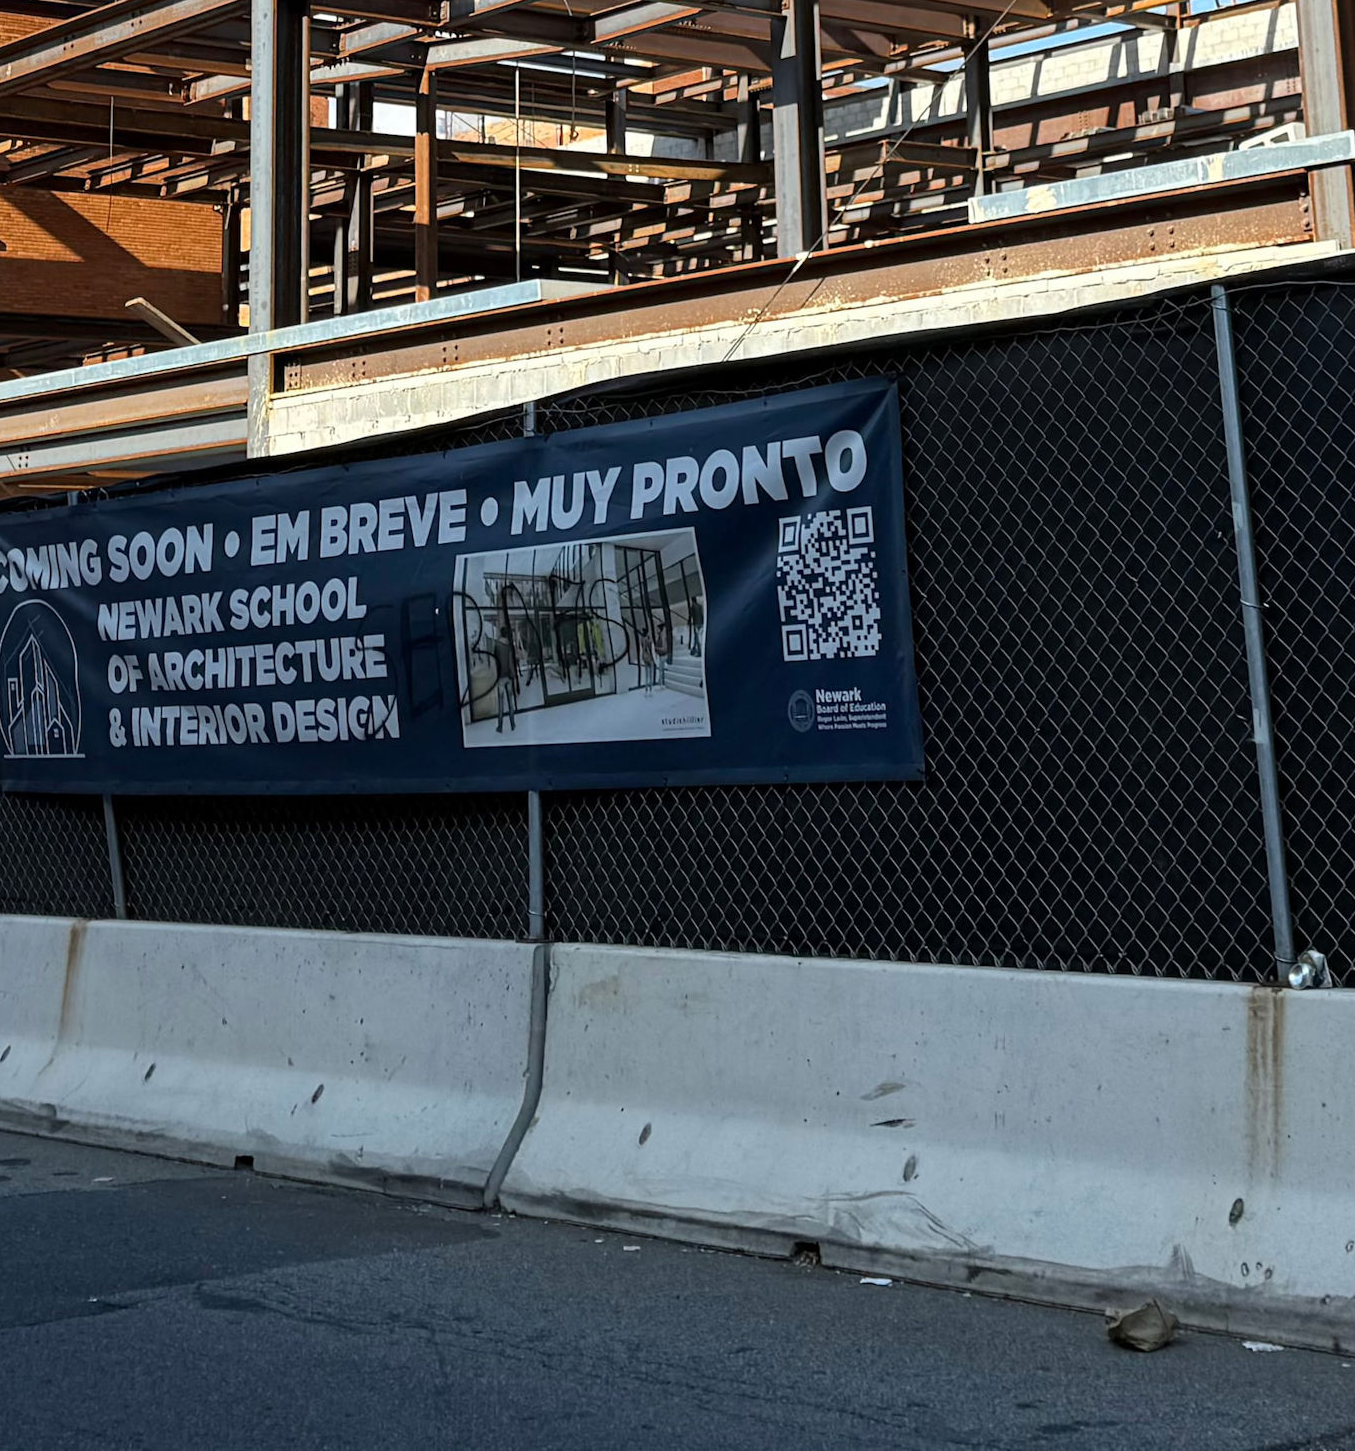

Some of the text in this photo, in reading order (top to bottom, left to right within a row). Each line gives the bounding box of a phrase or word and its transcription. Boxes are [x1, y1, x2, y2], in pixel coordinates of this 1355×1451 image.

[108, 523, 214, 584] SOON
[250, 510, 310, 566] EM
[320, 489, 467, 558] BREVE
[510, 466, 622, 535] MUY
[630, 430, 868, 520] PRONTO
[98, 576, 367, 641] NEWARK SCHOOL
[108, 634, 388, 694] OF ARCHITECTURE
[109, 695, 400, 748] & INTERIOR DESIGN
[815, 687, 862, 703] Newark
[816, 702, 886, 714] Board of Education
